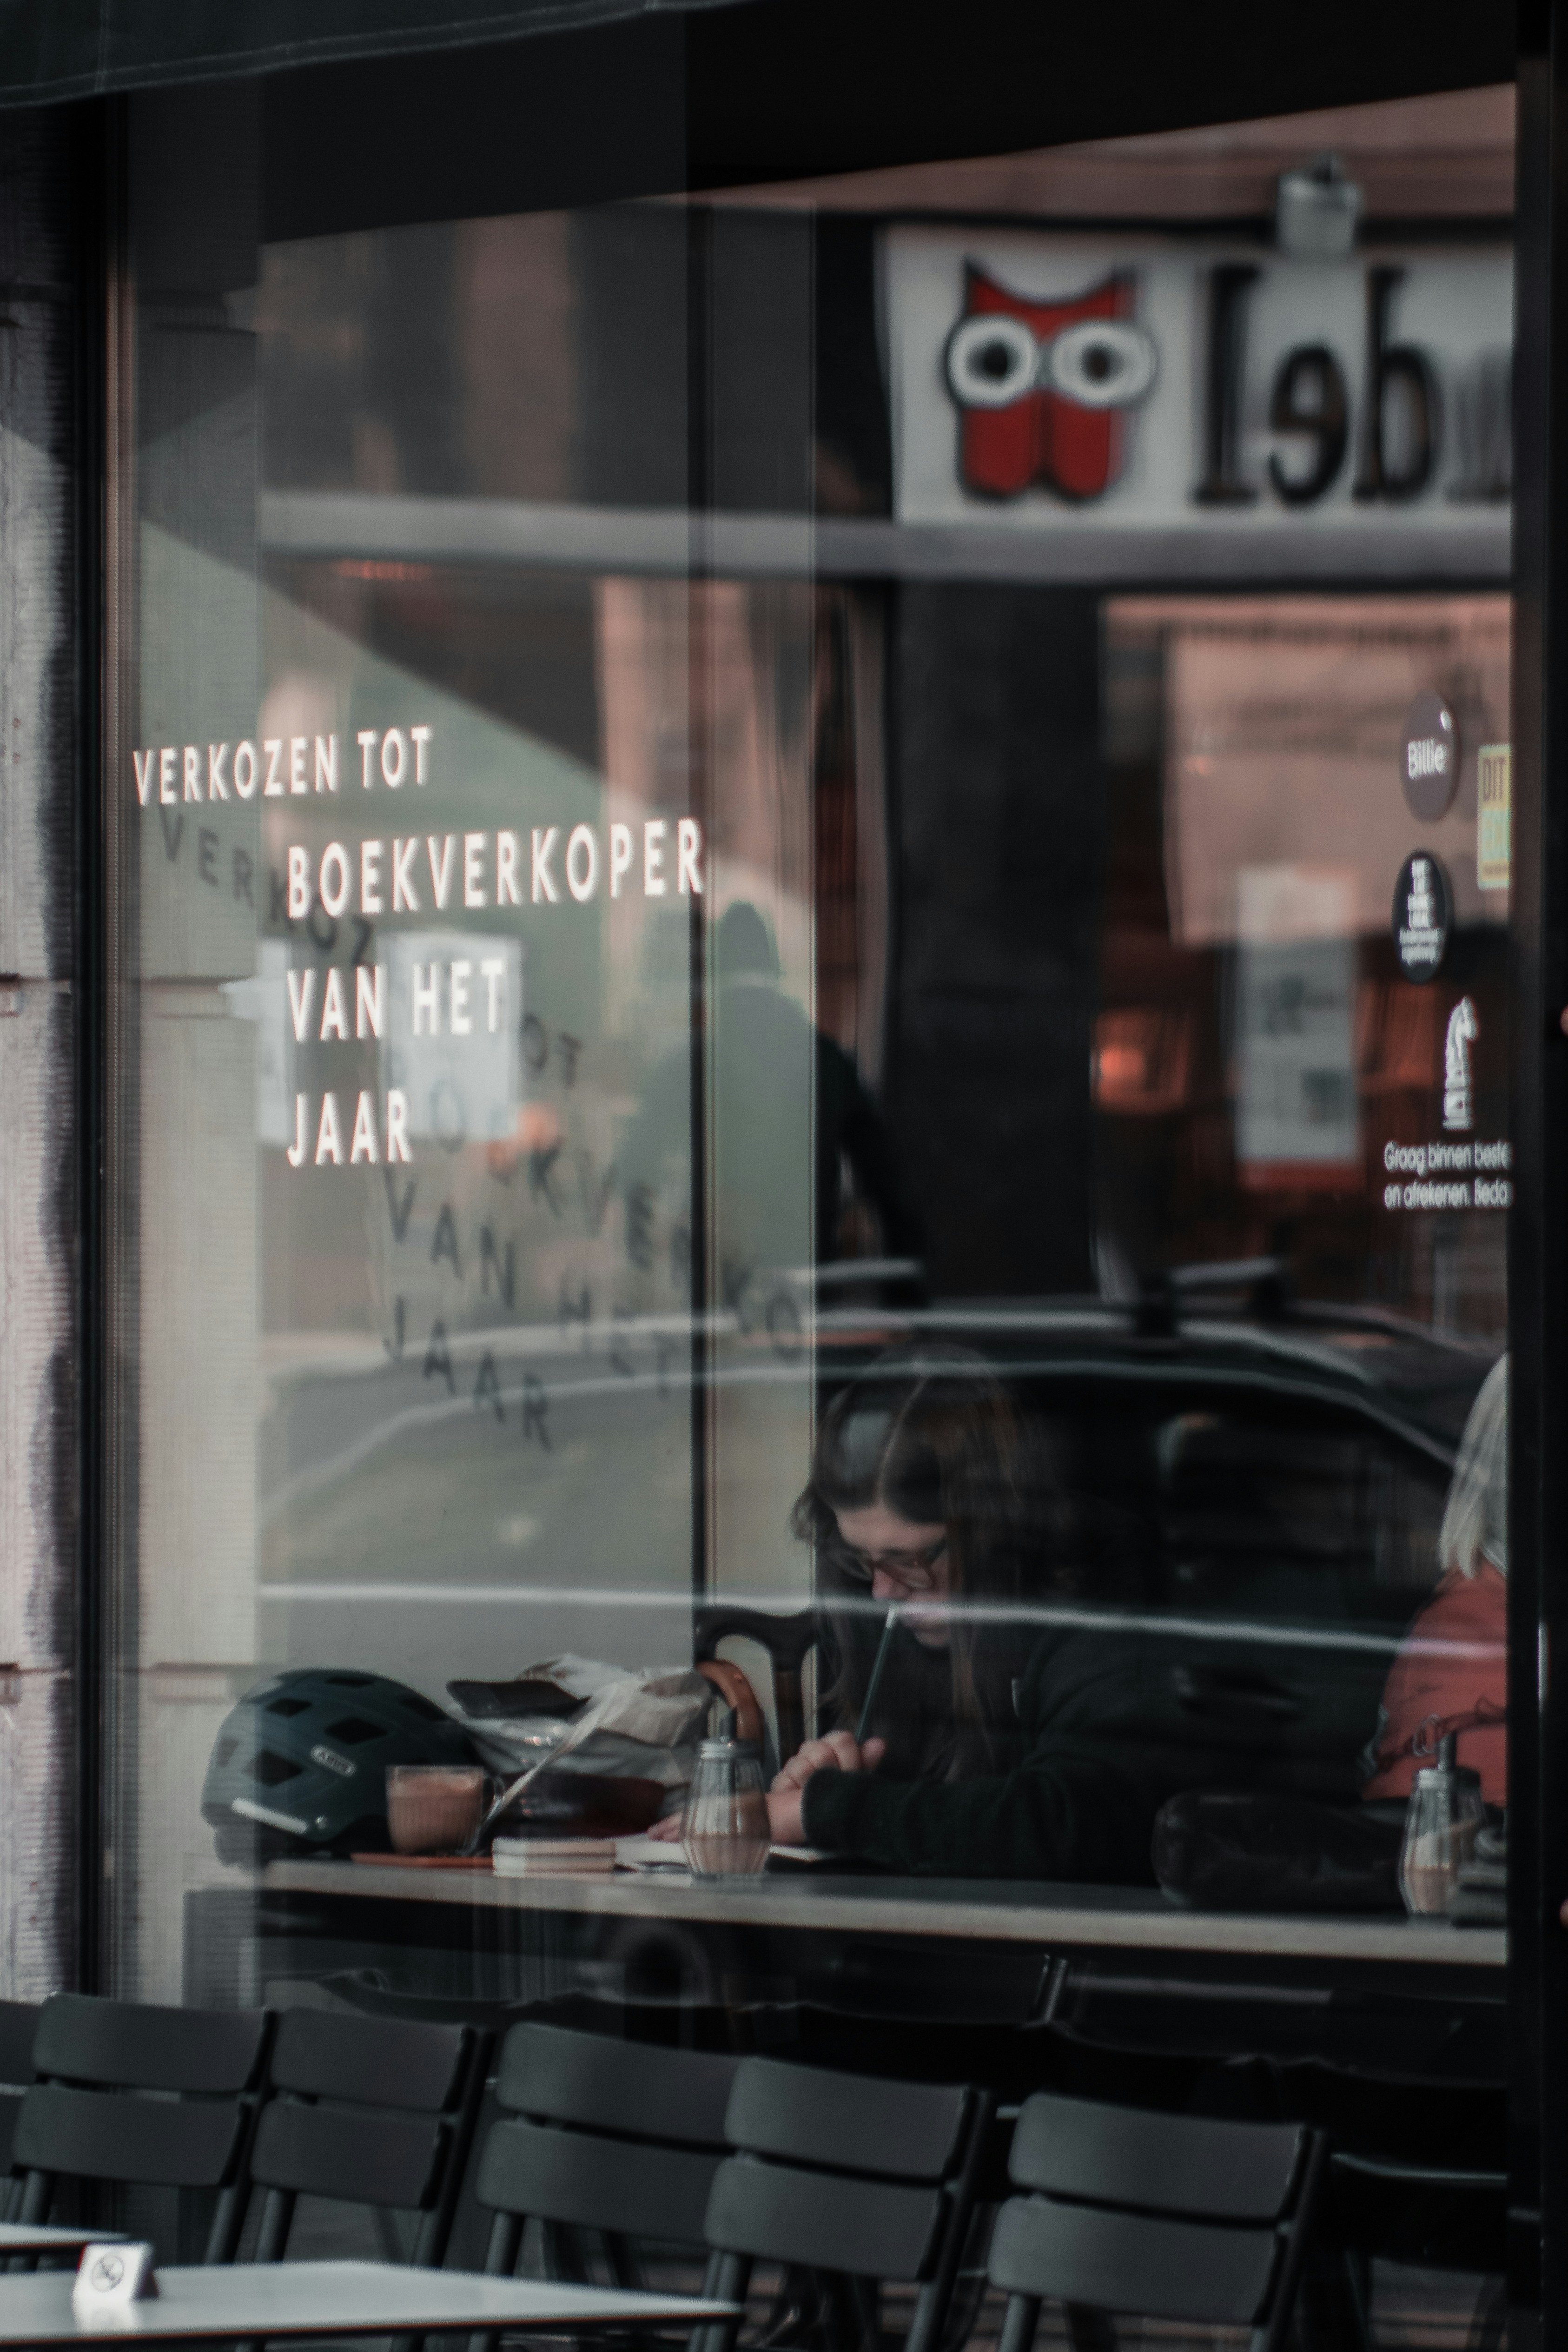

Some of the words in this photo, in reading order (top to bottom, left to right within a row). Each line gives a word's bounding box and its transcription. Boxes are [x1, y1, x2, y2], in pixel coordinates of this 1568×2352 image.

[133, 734, 337, 805] VERKOZEN
[357, 725, 432, 788] TOT
[287, 818, 703, 919] BOEKVERKOPER
[286, 963, 386, 1042] VAN
[412, 958, 507, 1036] HET
[286, 1087, 411, 1167] JAAR
[1384, 1141, 1426, 1176] Graag
[1384, 1184, 1401, 1209] en
